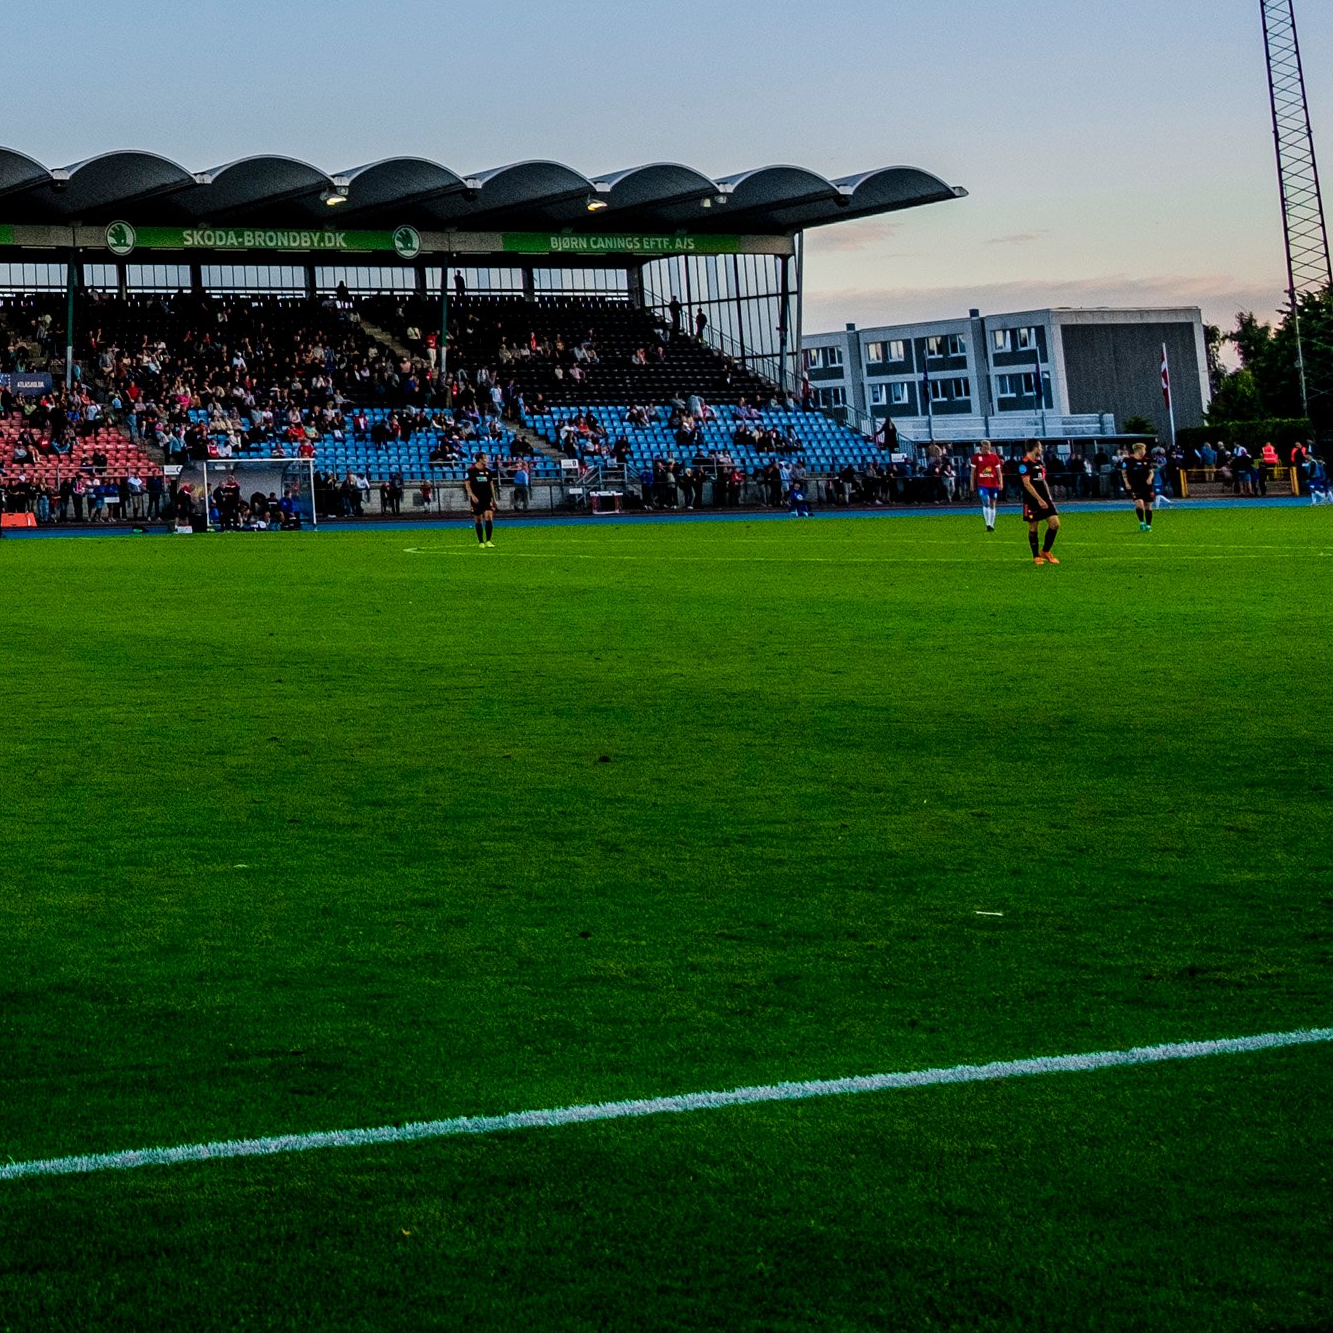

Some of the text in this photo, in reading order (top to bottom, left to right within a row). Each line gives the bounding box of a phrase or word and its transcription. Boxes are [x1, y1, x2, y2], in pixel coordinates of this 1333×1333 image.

[182, 230, 347, 247] SKODA-BRONDBY.DK
[550, 236, 695, 251] BJØRN CANINGS EFTF. A/S
